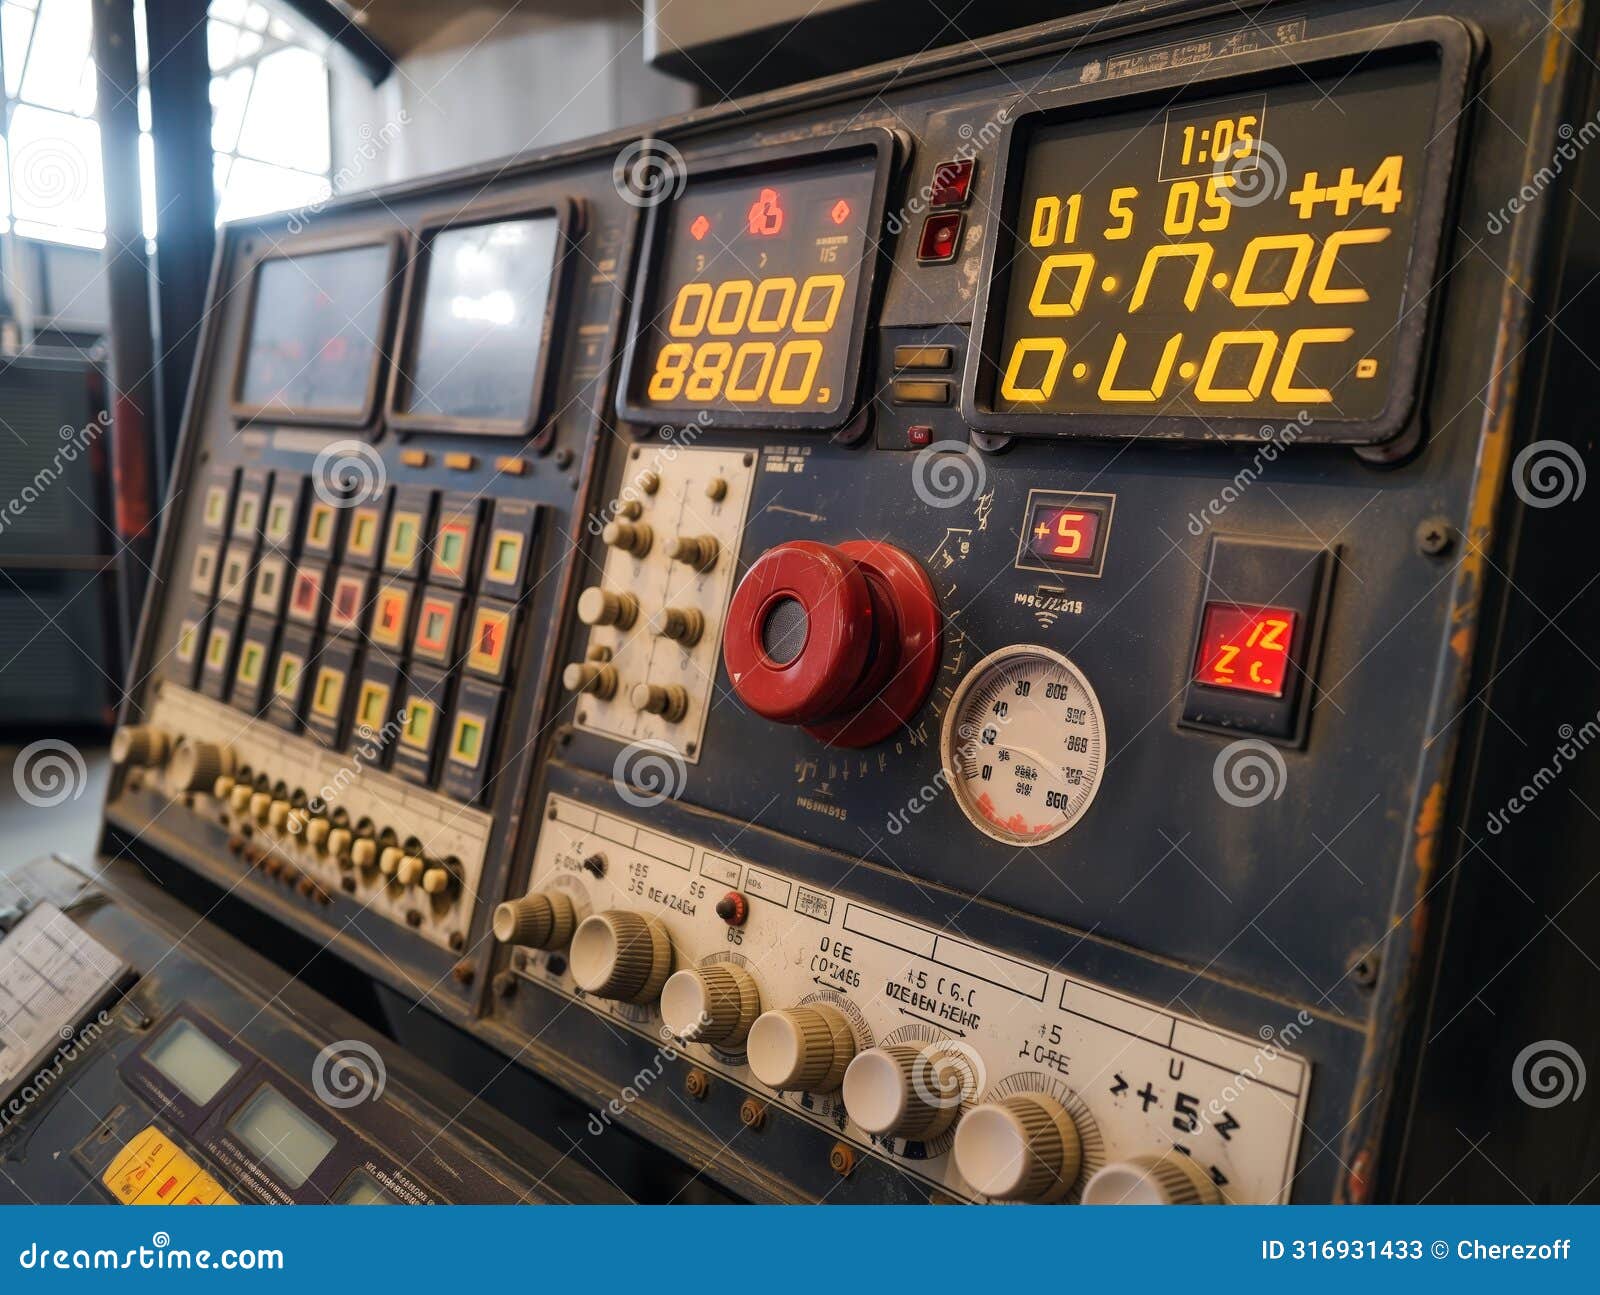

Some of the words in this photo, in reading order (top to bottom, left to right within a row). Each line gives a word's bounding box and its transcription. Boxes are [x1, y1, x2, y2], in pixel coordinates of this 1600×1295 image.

[1181, 115, 1257, 165] 1:05
[1163, 174, 1237, 236] 05
[668, 274, 846, 337] 0000
[648, 340, 823, 405] 8800
